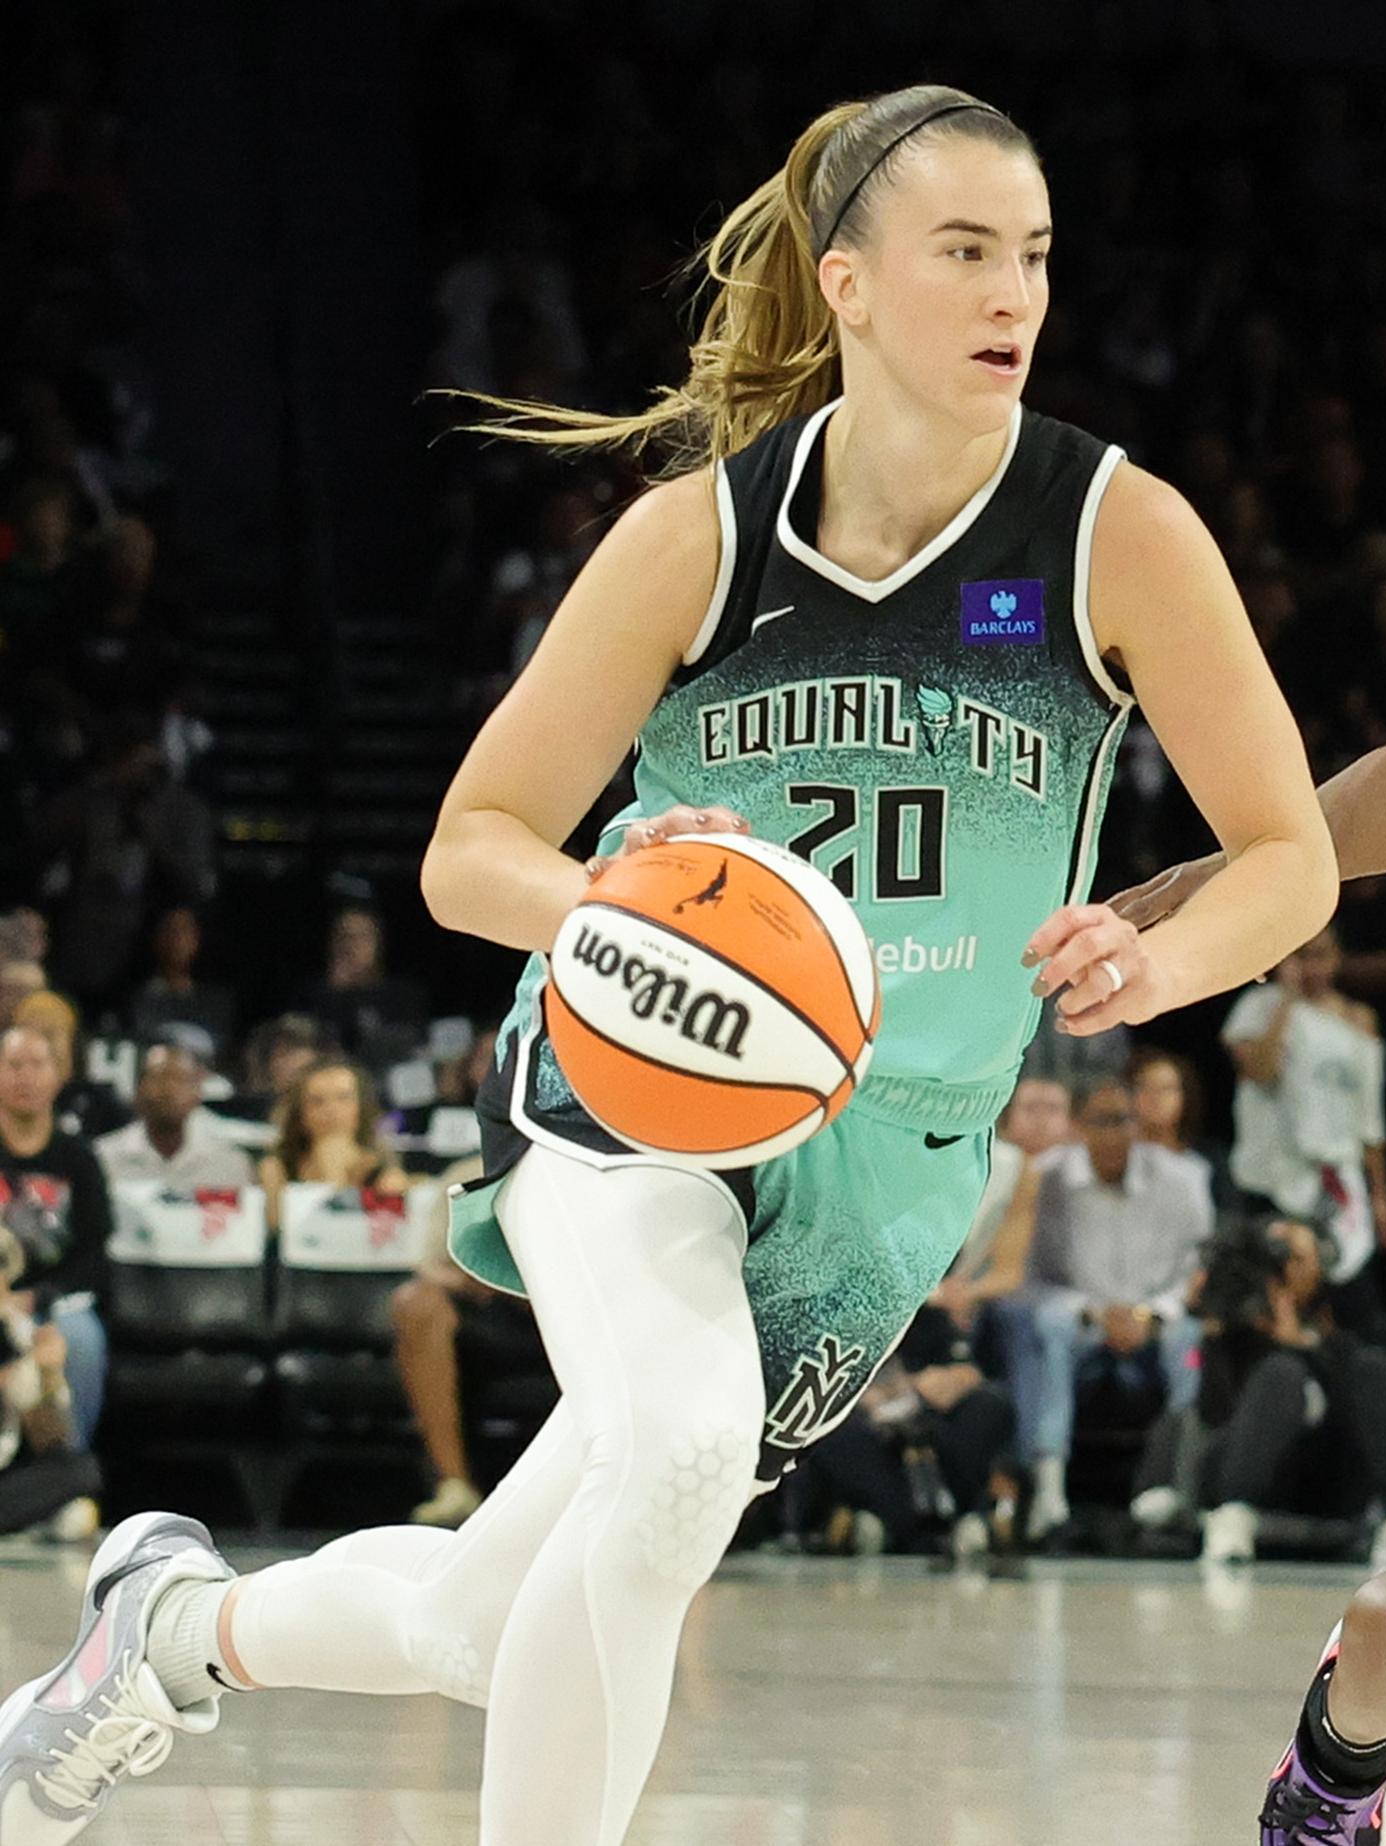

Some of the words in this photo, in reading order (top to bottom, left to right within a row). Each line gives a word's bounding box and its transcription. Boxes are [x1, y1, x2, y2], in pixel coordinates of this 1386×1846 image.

[970, 619, 1037, 636] BARCLAYS
[784, 782, 950, 903] 20
[571, 923, 752, 1061] Wilson
[868, 934, 978, 974] ebull
